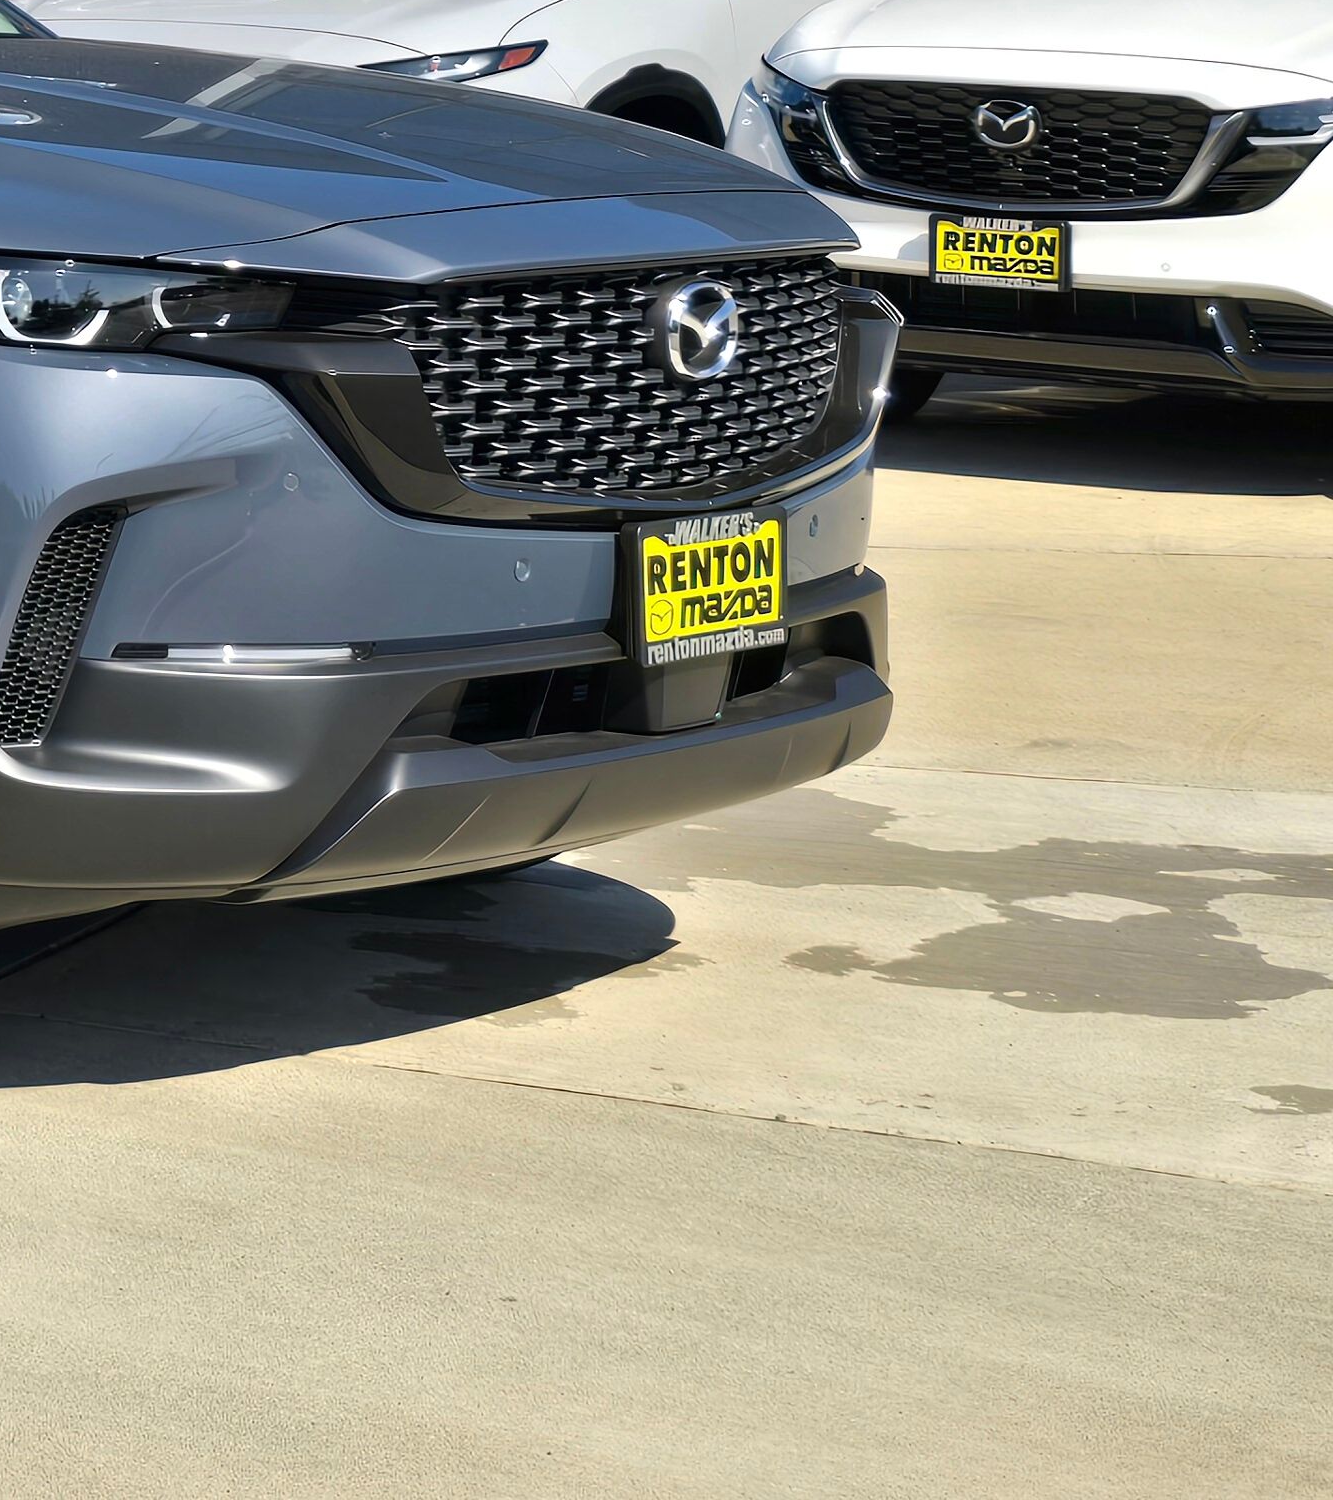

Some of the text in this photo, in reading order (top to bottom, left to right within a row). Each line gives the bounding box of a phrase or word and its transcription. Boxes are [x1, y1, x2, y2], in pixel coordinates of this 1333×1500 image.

[944, 231, 1057, 257] RENTON
[674, 511, 755, 547] WALKER'S
[647, 537, 775, 596] RENTON
[680, 584, 773, 629] mazda
[647, 626, 785, 665] rentonmazda.com
